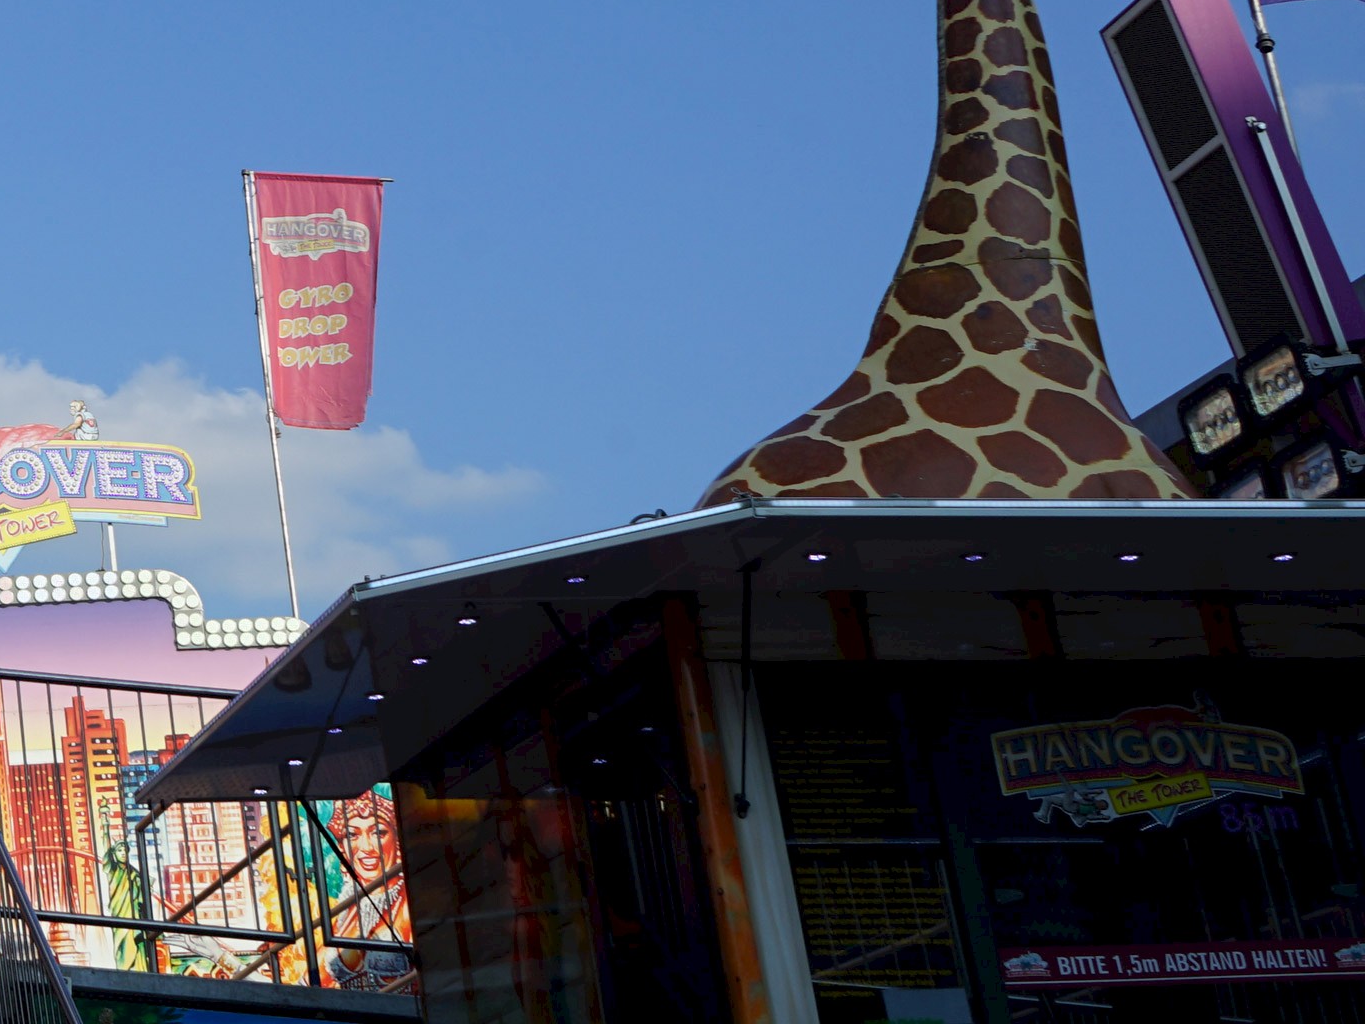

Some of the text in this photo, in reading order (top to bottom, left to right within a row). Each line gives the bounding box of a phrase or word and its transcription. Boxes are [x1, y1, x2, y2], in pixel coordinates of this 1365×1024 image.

[267, 222, 366, 244] HANGOVER
[278, 282, 354, 309] GYRO
[278, 314, 348, 339] DROP
[277, 343, 353, 370] OWER
[1001, 726, 1292, 777] HANGOVER
[1115, 779, 1205, 810] THE TOWER
[1056, 948, 1327, 977] BITTE 1,5m ABSTAND HALTEN!
